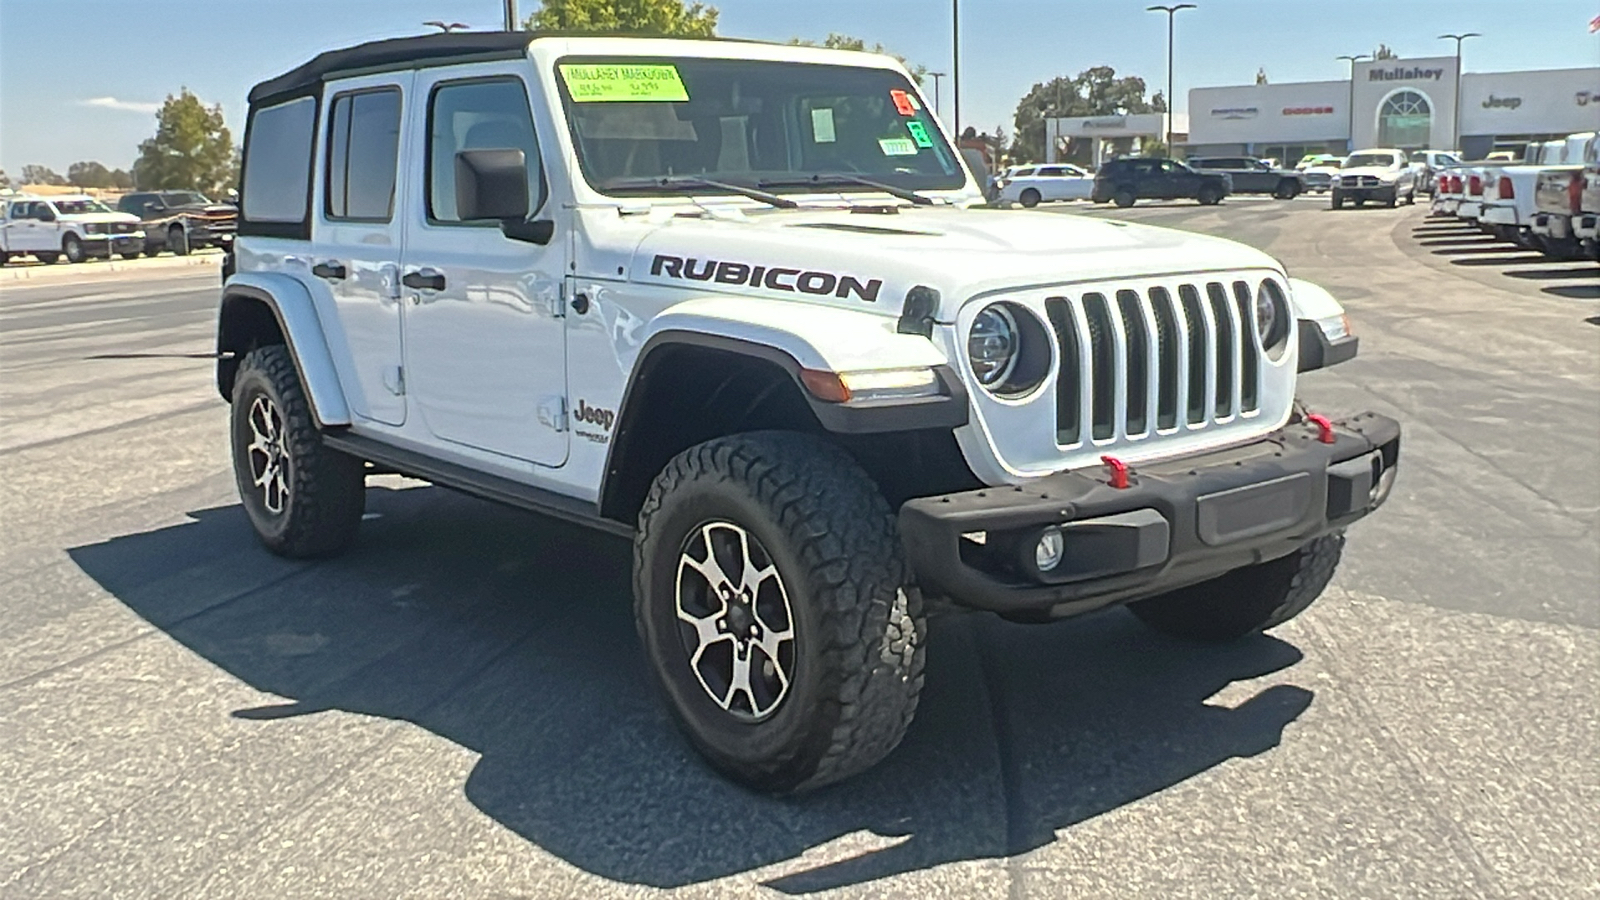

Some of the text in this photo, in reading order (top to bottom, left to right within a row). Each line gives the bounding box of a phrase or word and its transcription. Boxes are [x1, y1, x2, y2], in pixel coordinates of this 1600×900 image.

[1369, 67, 1443, 81] Mullahey
[1482, 94, 1522, 110] Jeep
[650, 254, 882, 302] RUBICON
[573, 399, 614, 432] Jeep
